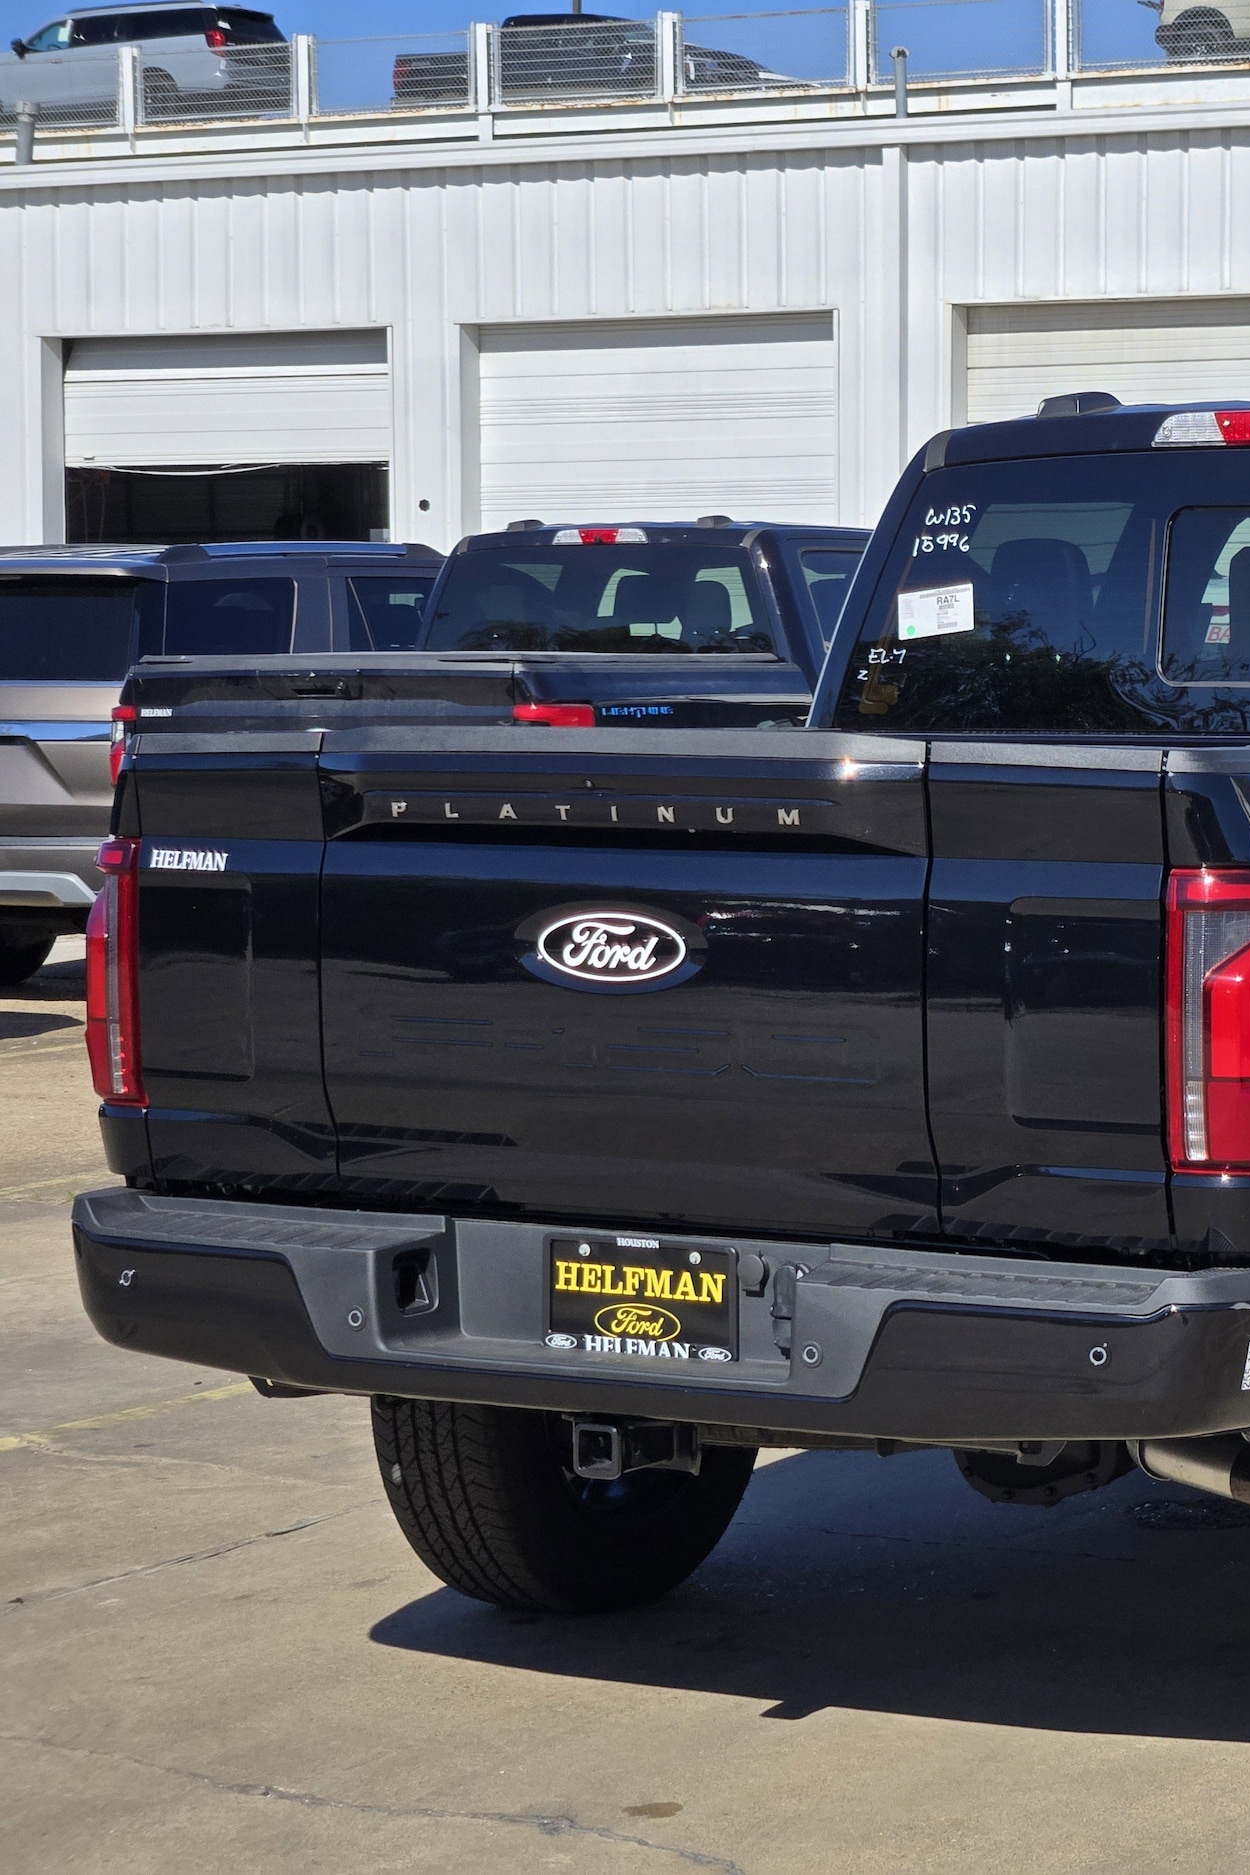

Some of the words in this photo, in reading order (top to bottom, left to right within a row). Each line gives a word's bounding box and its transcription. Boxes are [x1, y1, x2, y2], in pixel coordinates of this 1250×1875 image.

[391, 801, 801, 826] PLATINUM
[150, 849, 228, 872] HELFMAN
[562, 921, 660, 971] Ford
[616, 1237, 660, 1249] HOUSTON
[554, 1260, 727, 1303] HELFMAN
[610, 1307, 665, 1337] Ford
[584, 1334, 691, 1359] HELFMAN
